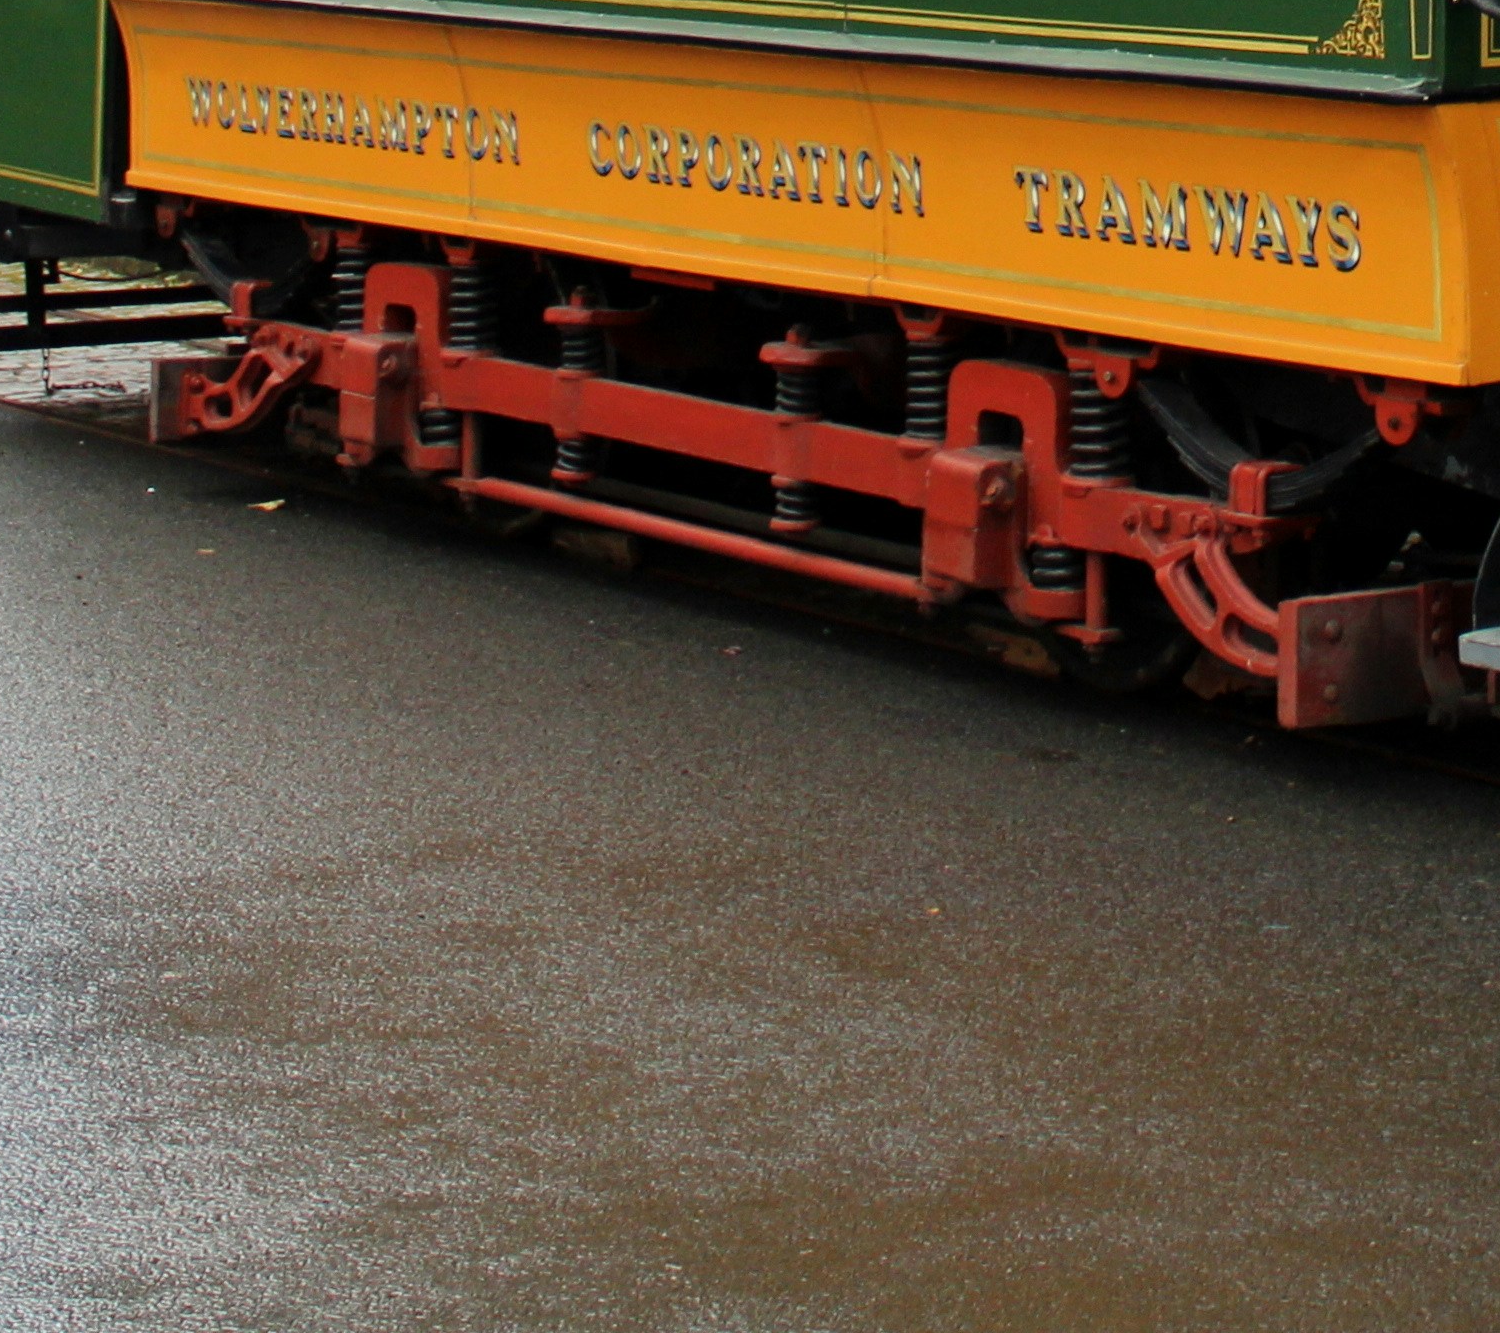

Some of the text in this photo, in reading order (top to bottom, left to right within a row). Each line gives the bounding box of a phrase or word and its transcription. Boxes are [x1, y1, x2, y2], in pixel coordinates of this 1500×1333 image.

[183, 76, 520, 165] WOLVERHAMPTON
[586, 118, 925, 217] CORPORATION
[1013, 165, 1362, 272] TRAMWAYS
